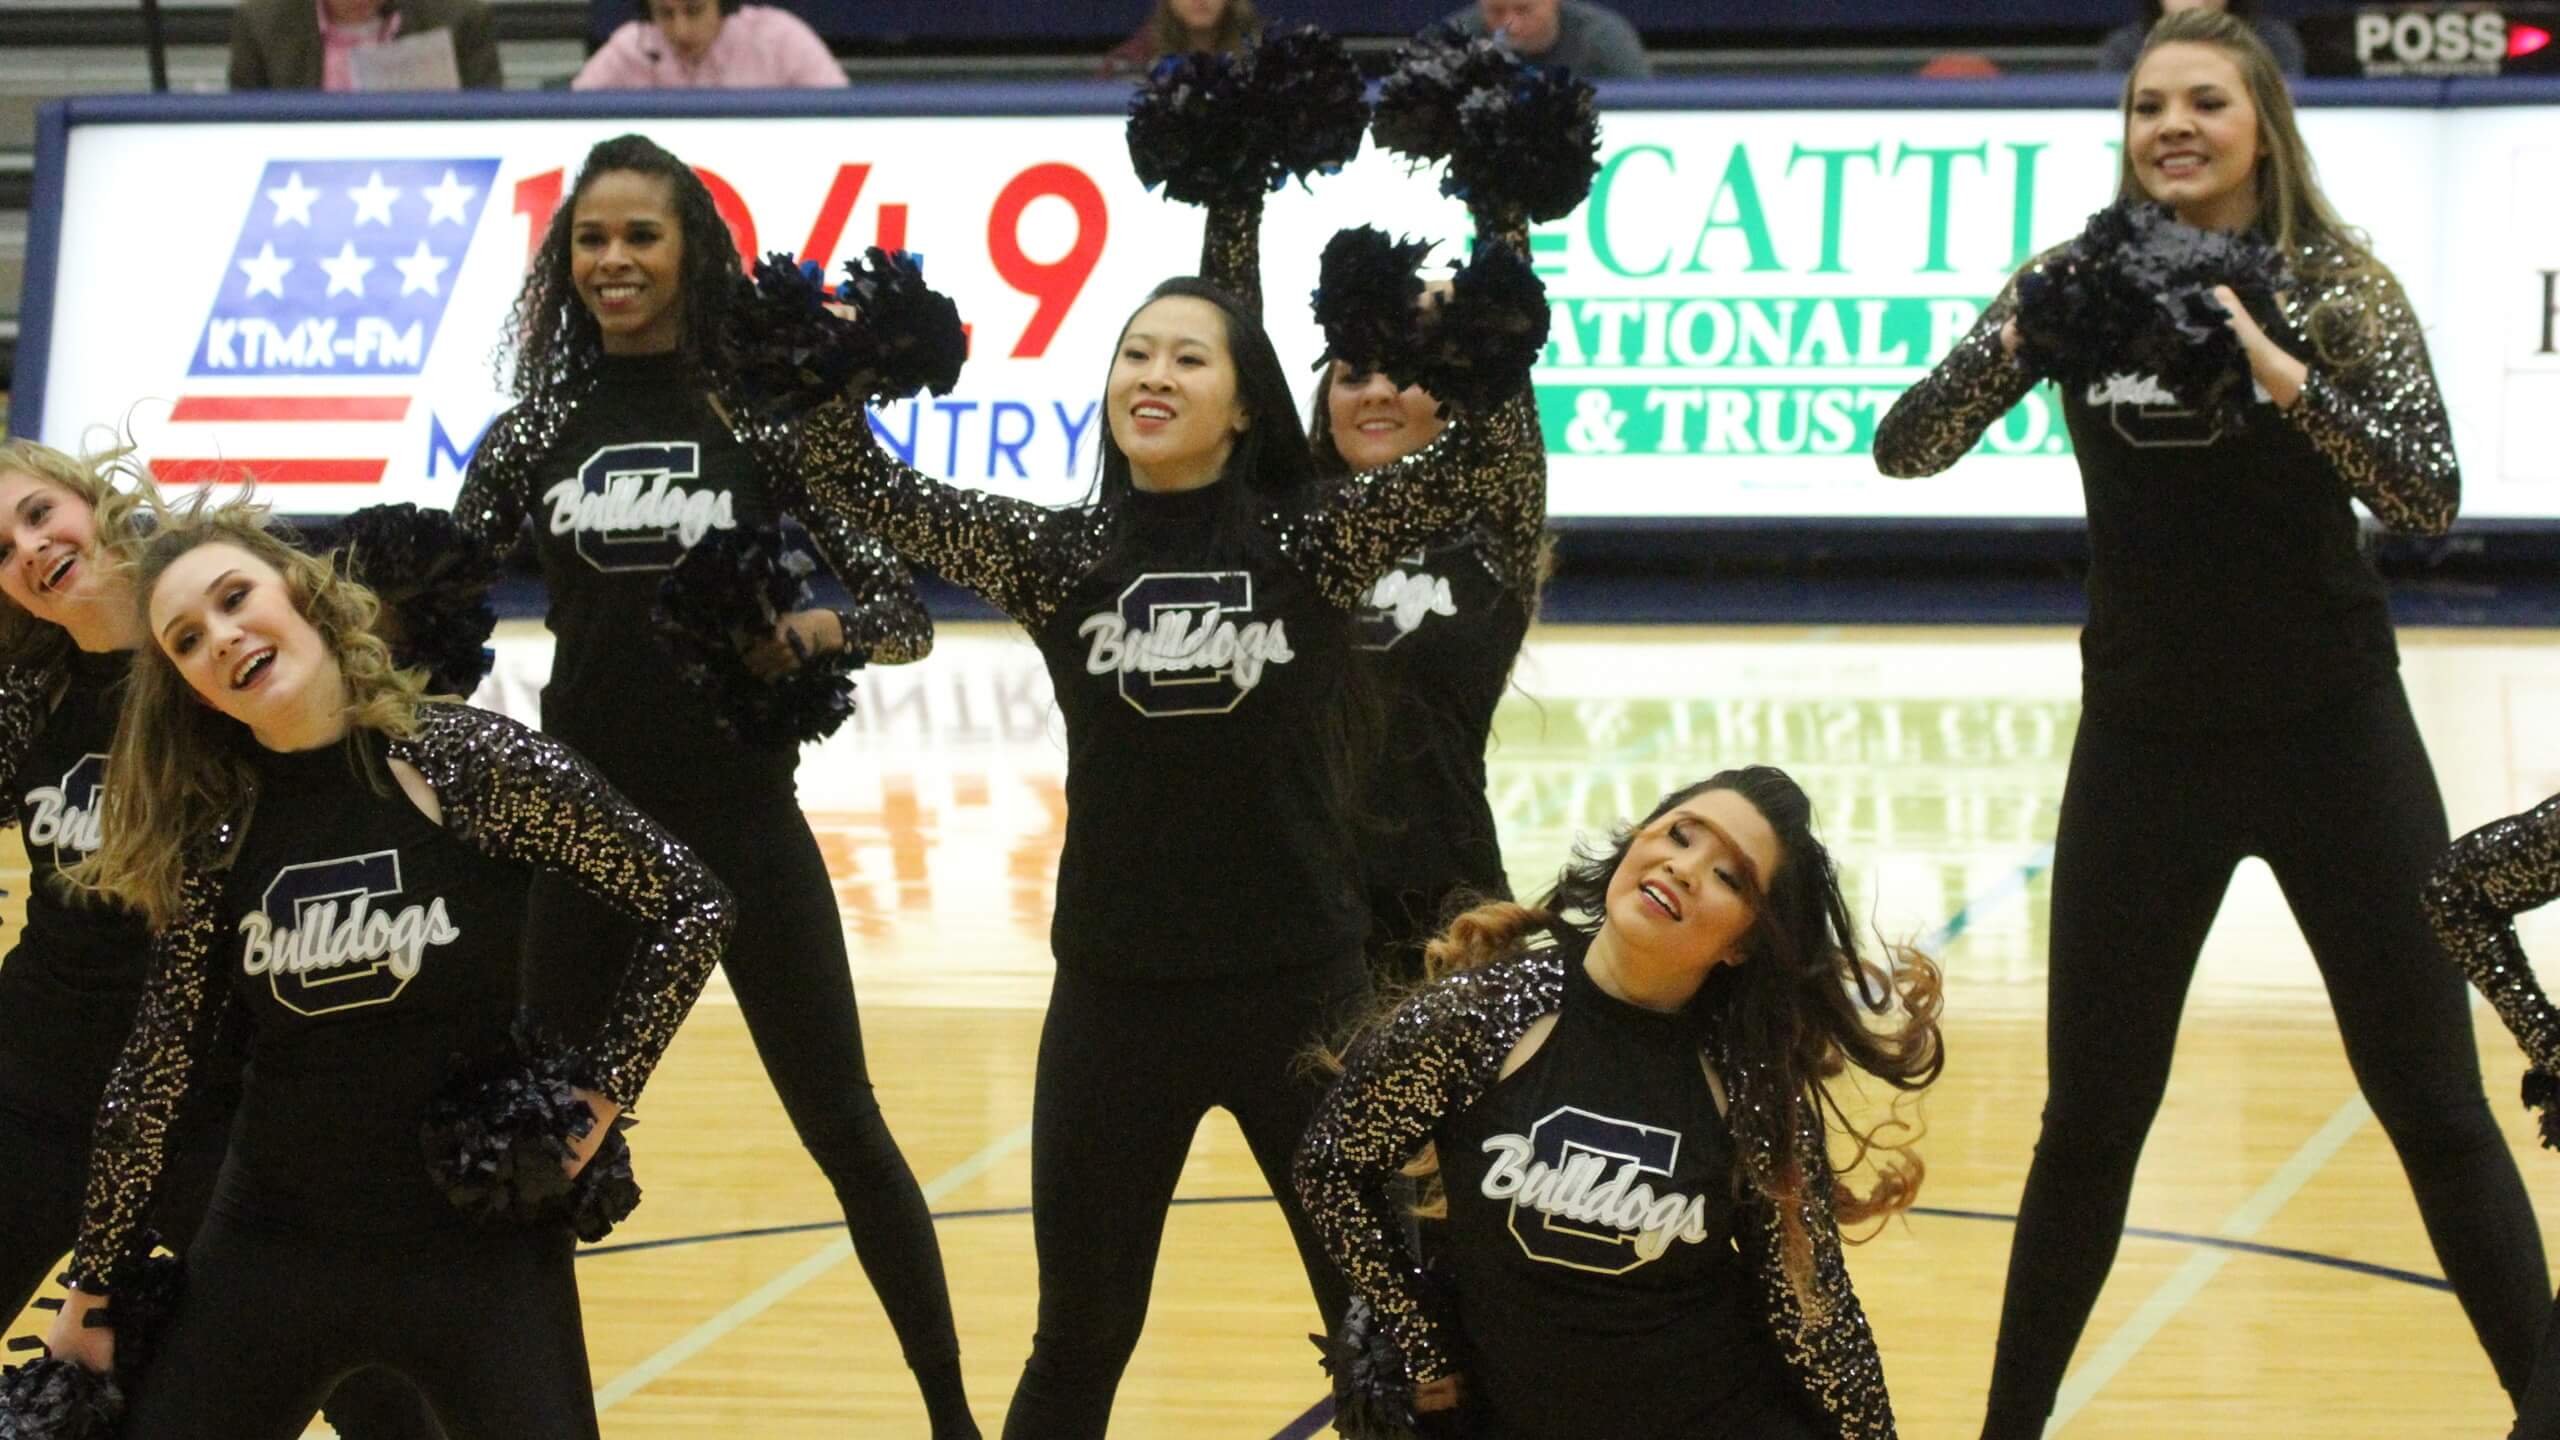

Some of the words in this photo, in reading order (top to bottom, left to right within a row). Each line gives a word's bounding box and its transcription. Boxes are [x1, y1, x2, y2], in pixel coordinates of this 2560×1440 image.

[2356, 12, 2507, 63] POSS
[1587, 141, 2125, 278] CATTL
[206, 315, 425, 369] KTMX-FM
[1538, 299, 1908, 366] ATIONAL
[864, 402, 1097, 477] NTRY
[1564, 388, 1628, 453] &
[1975, 391, 2064, 453] O.
[543, 477, 737, 549] Bulldogs
[1078, 609, 1296, 690] Bulldogs
[239, 897, 460, 980] Bulldogs
[1481, 1133, 1708, 1261] Bulldogs
